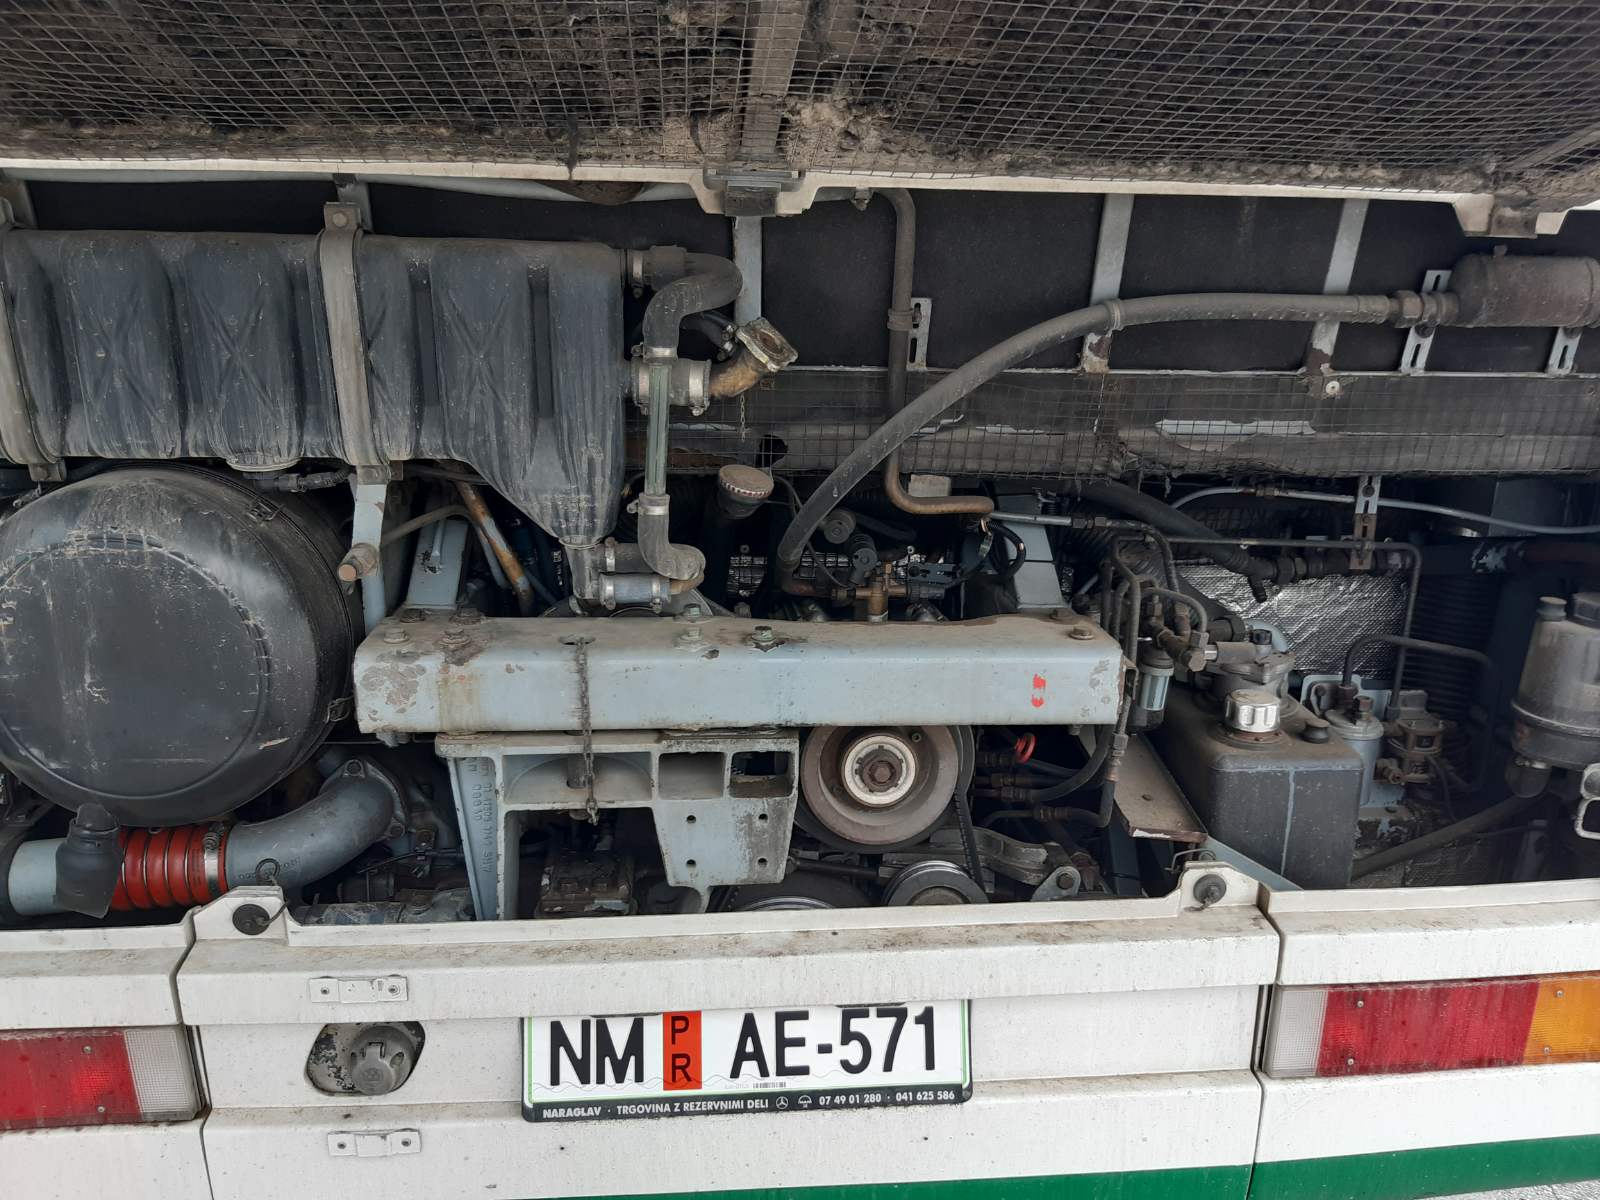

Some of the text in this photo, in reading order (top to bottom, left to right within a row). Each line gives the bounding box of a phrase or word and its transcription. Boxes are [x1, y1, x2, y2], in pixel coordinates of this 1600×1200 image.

[550, 1017, 644, 1086] NM
[729, 1006, 935, 1079] AE-571
[818, 1095, 832, 1106] 07
[833, 1095, 846, 1105] 49
[849, 1094, 860, 1105] 01
[863, 1093, 882, 1104] 280
[895, 1091, 913, 1102] 041
[916, 1090, 935, 1101] 625
[937, 1089, 955, 1101] 586
[542, 1098, 769, 1119] NARAGLAV TRGOVINA Z REZERVNIMI DELI
